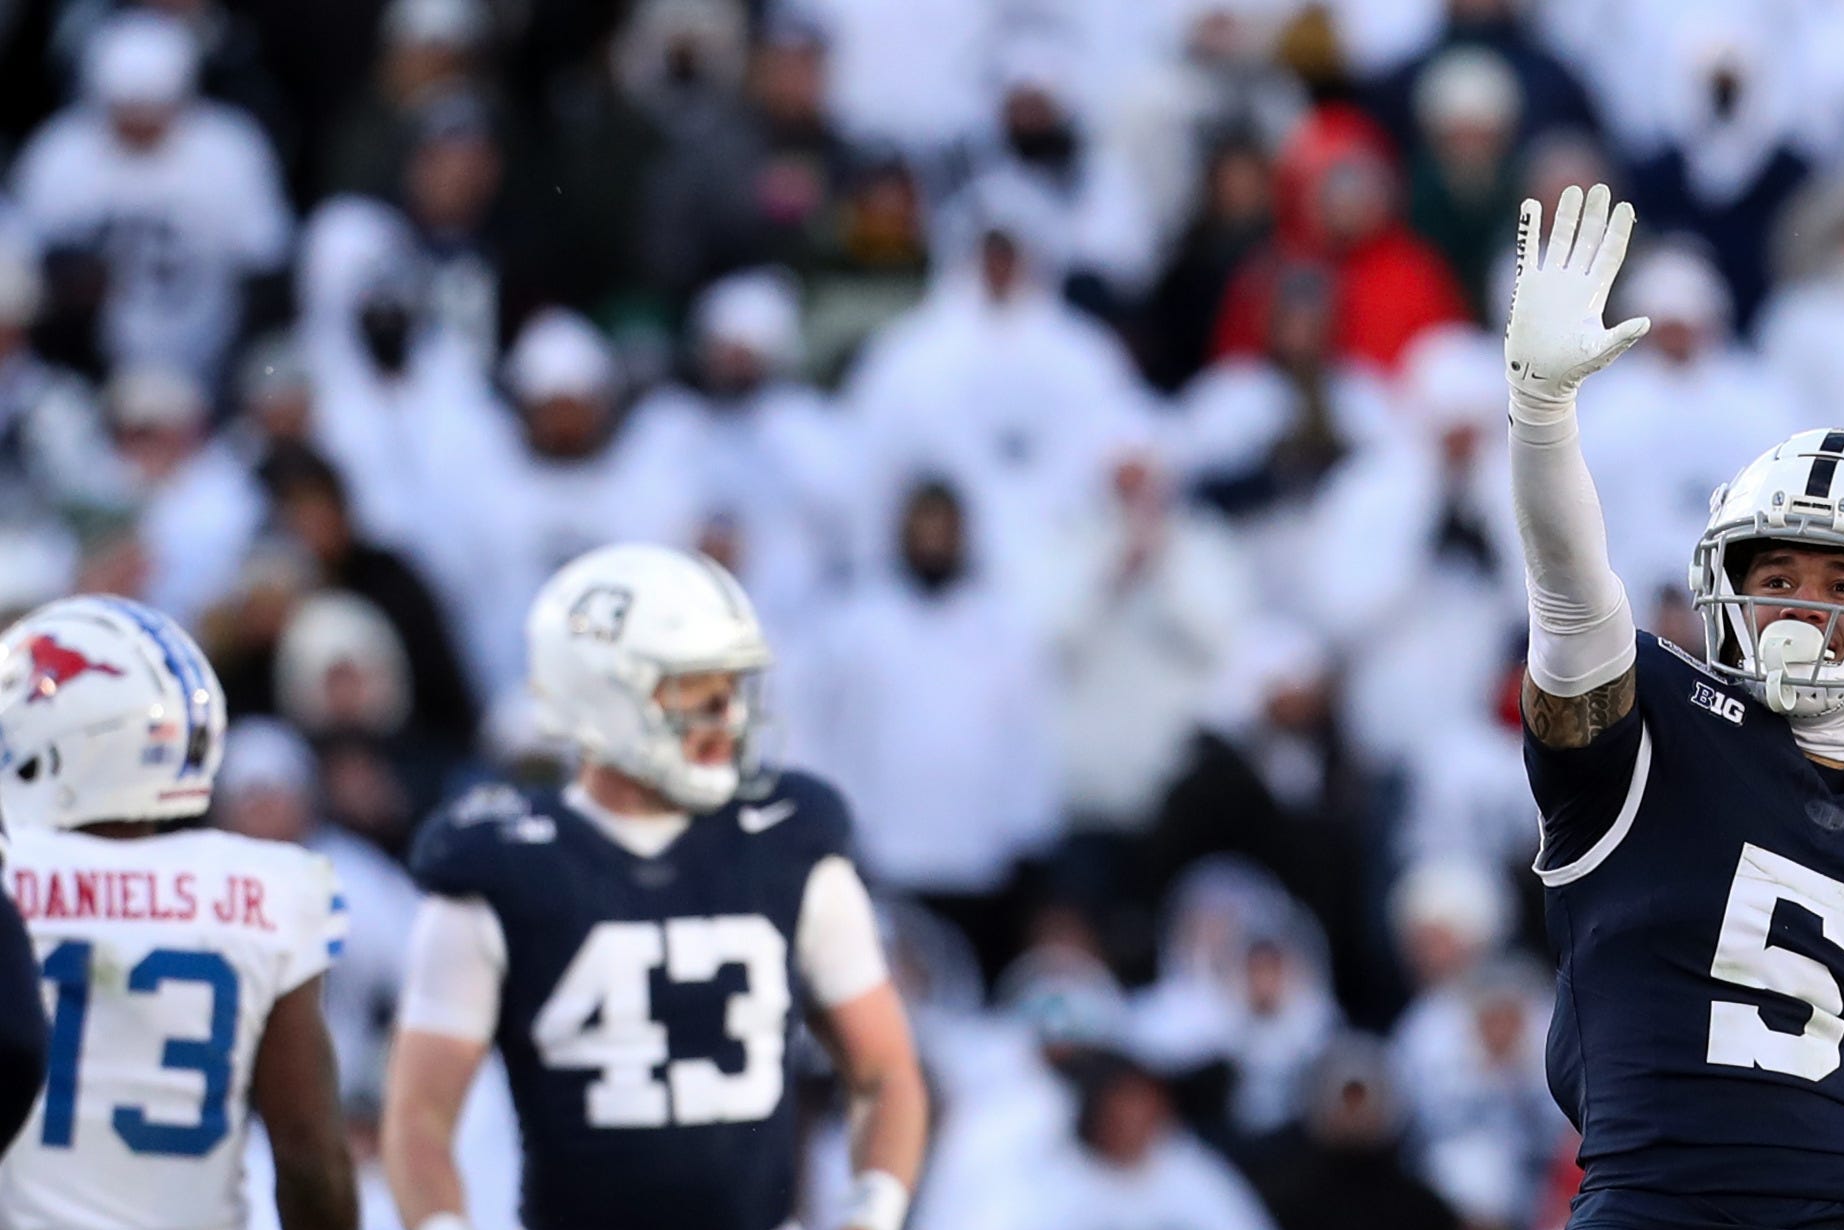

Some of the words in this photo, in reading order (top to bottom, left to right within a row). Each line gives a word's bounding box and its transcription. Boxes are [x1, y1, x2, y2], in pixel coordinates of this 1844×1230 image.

[14, 869, 198, 921] DANIELS
[40, 939, 240, 1157] 13
[532, 914, 791, 1128] 43
